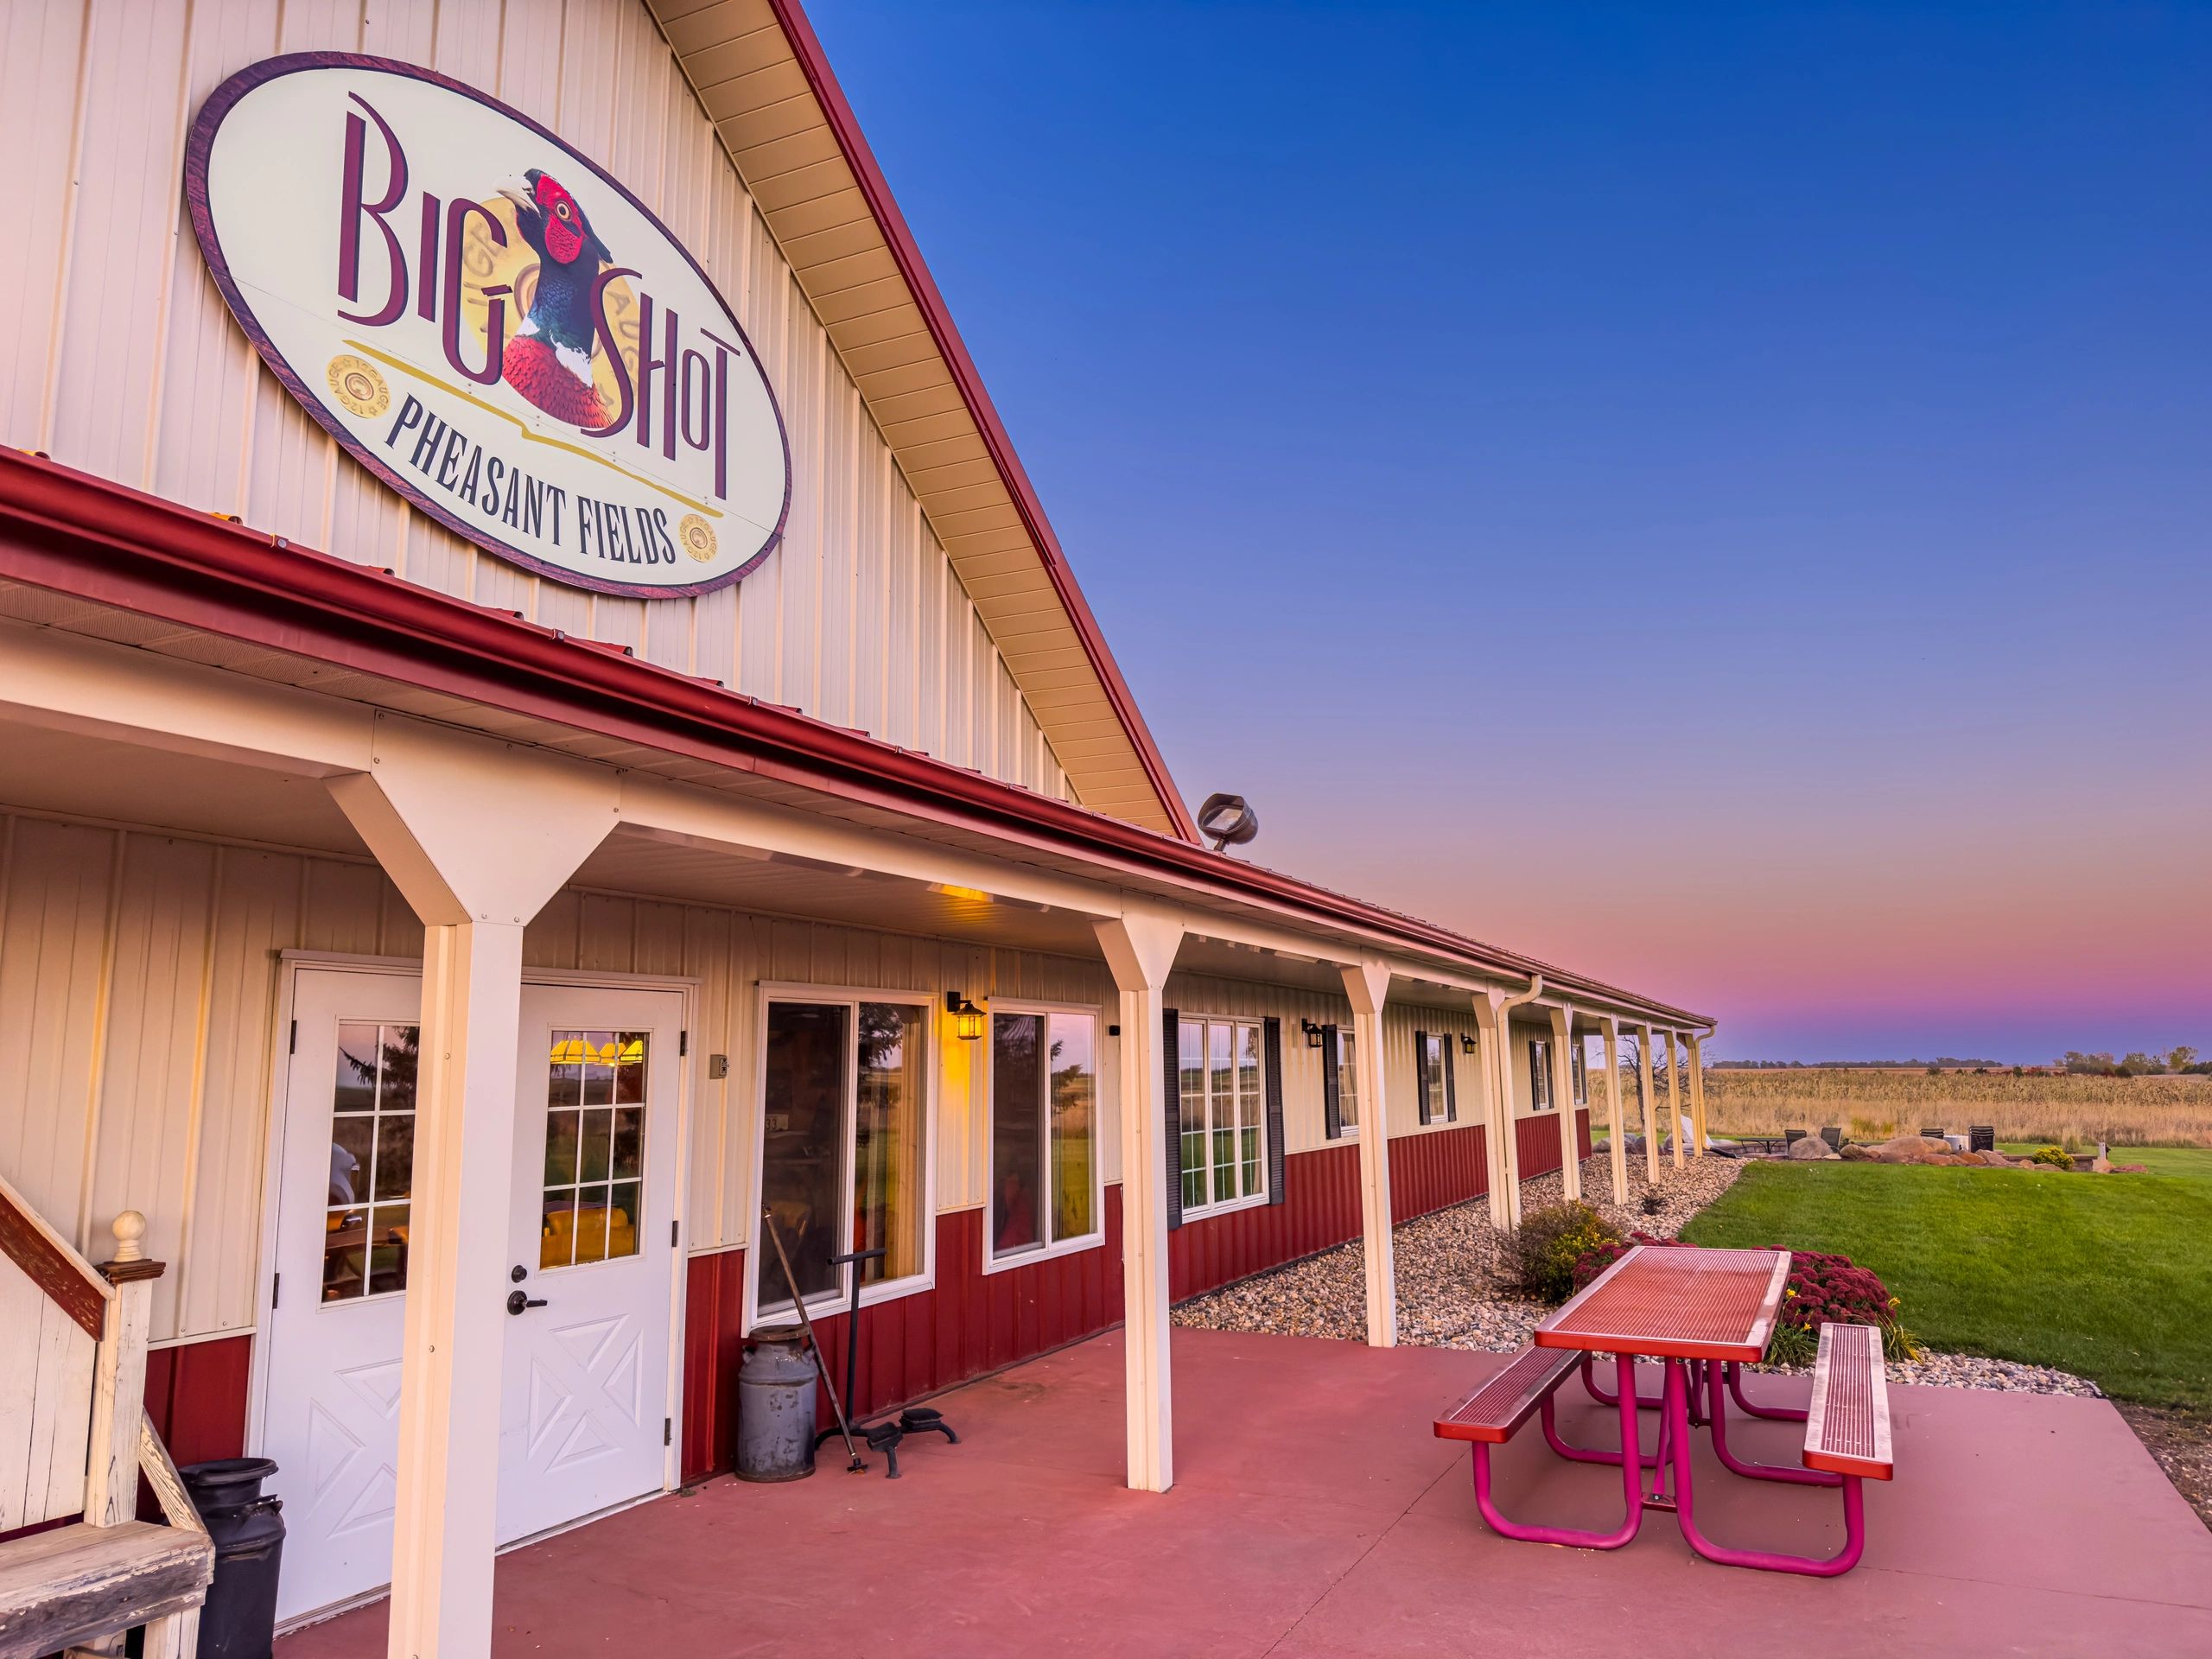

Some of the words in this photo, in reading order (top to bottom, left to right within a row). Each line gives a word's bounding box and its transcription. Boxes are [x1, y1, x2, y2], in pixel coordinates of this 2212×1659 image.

[338, 91, 513, 385] BIG
[581, 267, 741, 501] SHOT
[384, 393, 566, 546] PHEASANT
[576, 495, 676, 564] FIELDS
